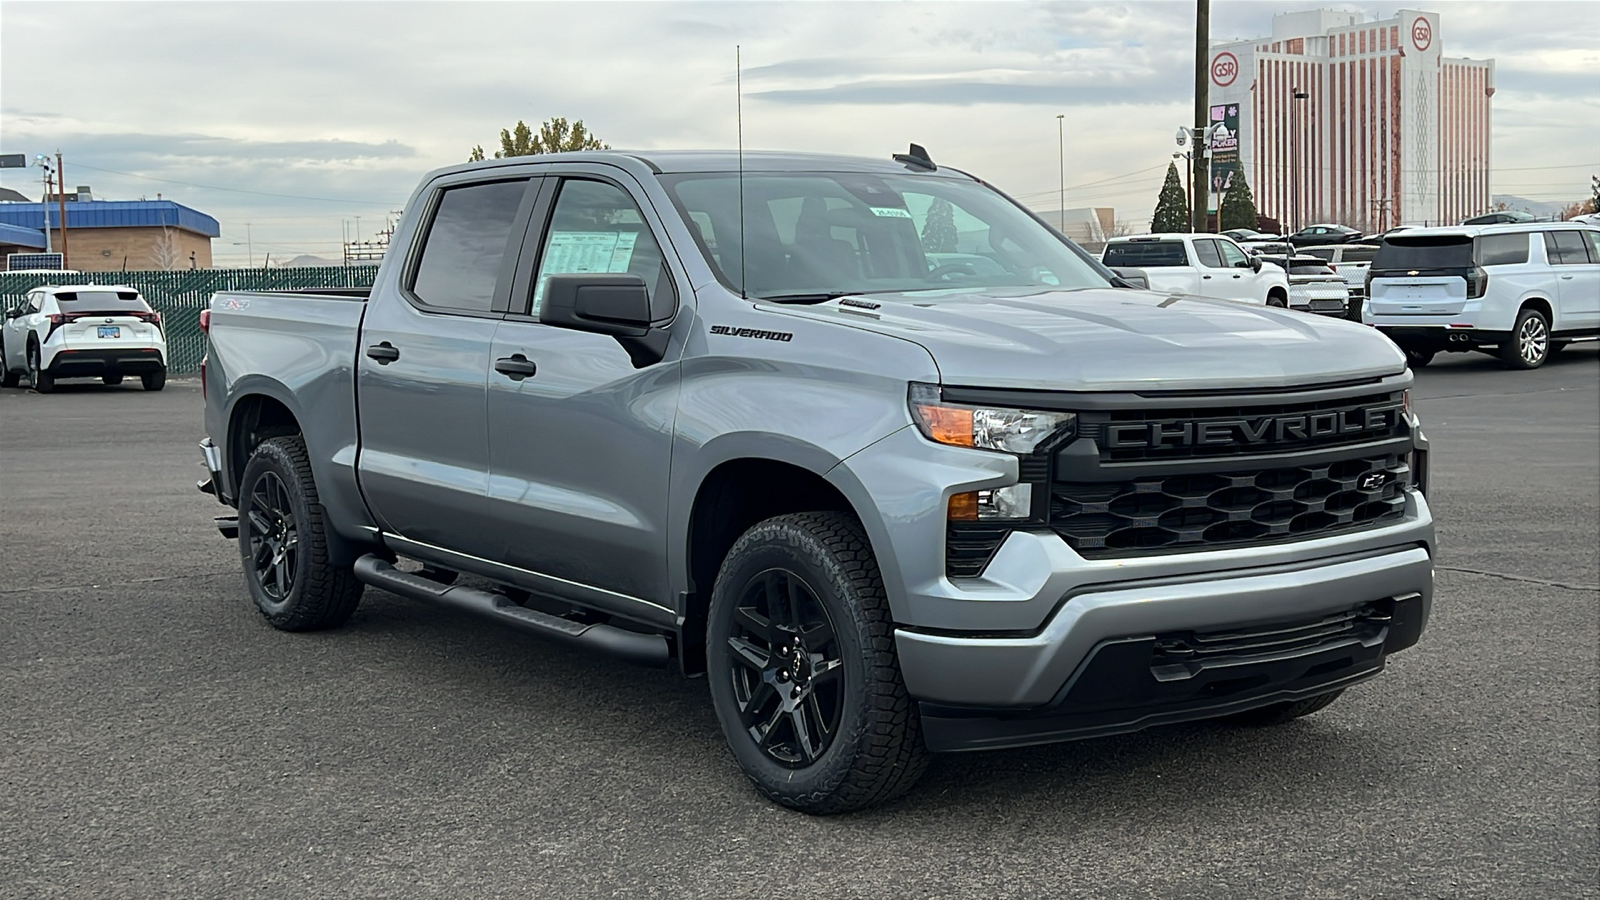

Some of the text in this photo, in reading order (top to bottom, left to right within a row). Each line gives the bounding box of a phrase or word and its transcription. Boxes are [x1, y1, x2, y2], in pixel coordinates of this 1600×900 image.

[1414, 27, 1429, 41] GSR
[1214, 62, 1235, 77] GSR
[1212, 138, 1237, 148] POKER
[710, 325, 793, 342] SILVERADO
[1107, 403, 1404, 448] CHEVROLET
